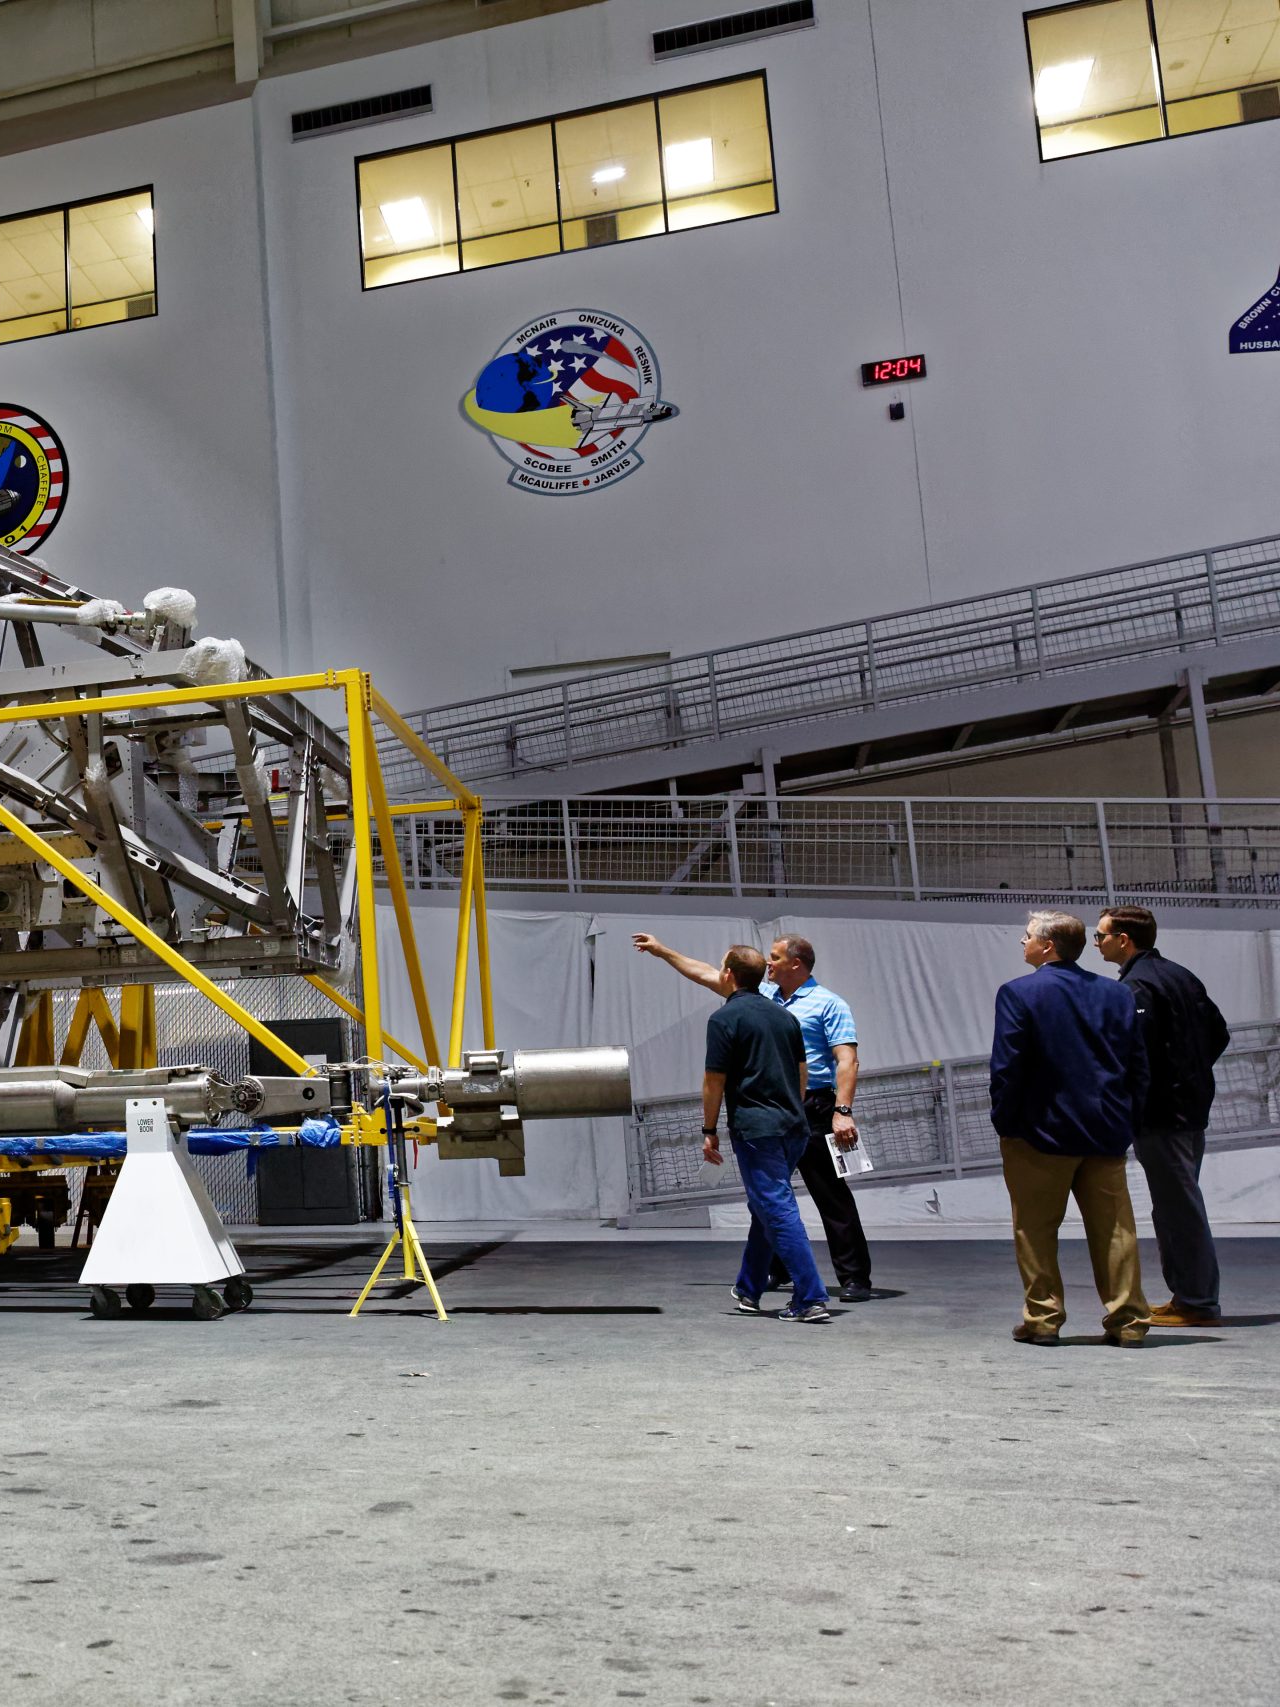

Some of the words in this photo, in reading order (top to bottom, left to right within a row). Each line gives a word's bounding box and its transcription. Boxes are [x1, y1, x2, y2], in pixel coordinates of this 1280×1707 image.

[1238, 298, 1272, 329] BROWN
[516, 317, 558, 344] MCNAIR
[578, 314, 625, 337] ONIZUKA
[634, 346, 653, 385] RESNIK
[1239, 340, 1280, 350] HUSBA
[875, 358, 921, 380] 12:04
[523, 456, 572, 473] SCOBEE
[590, 439, 627, 467] SMITH
[35, 455, 47, 507] CHAFFEE
[518, 473, 579, 490] MCAULIFFE
[593, 458, 631, 485] JARVIS
[137, 1118, 154, 1126] LOWER
